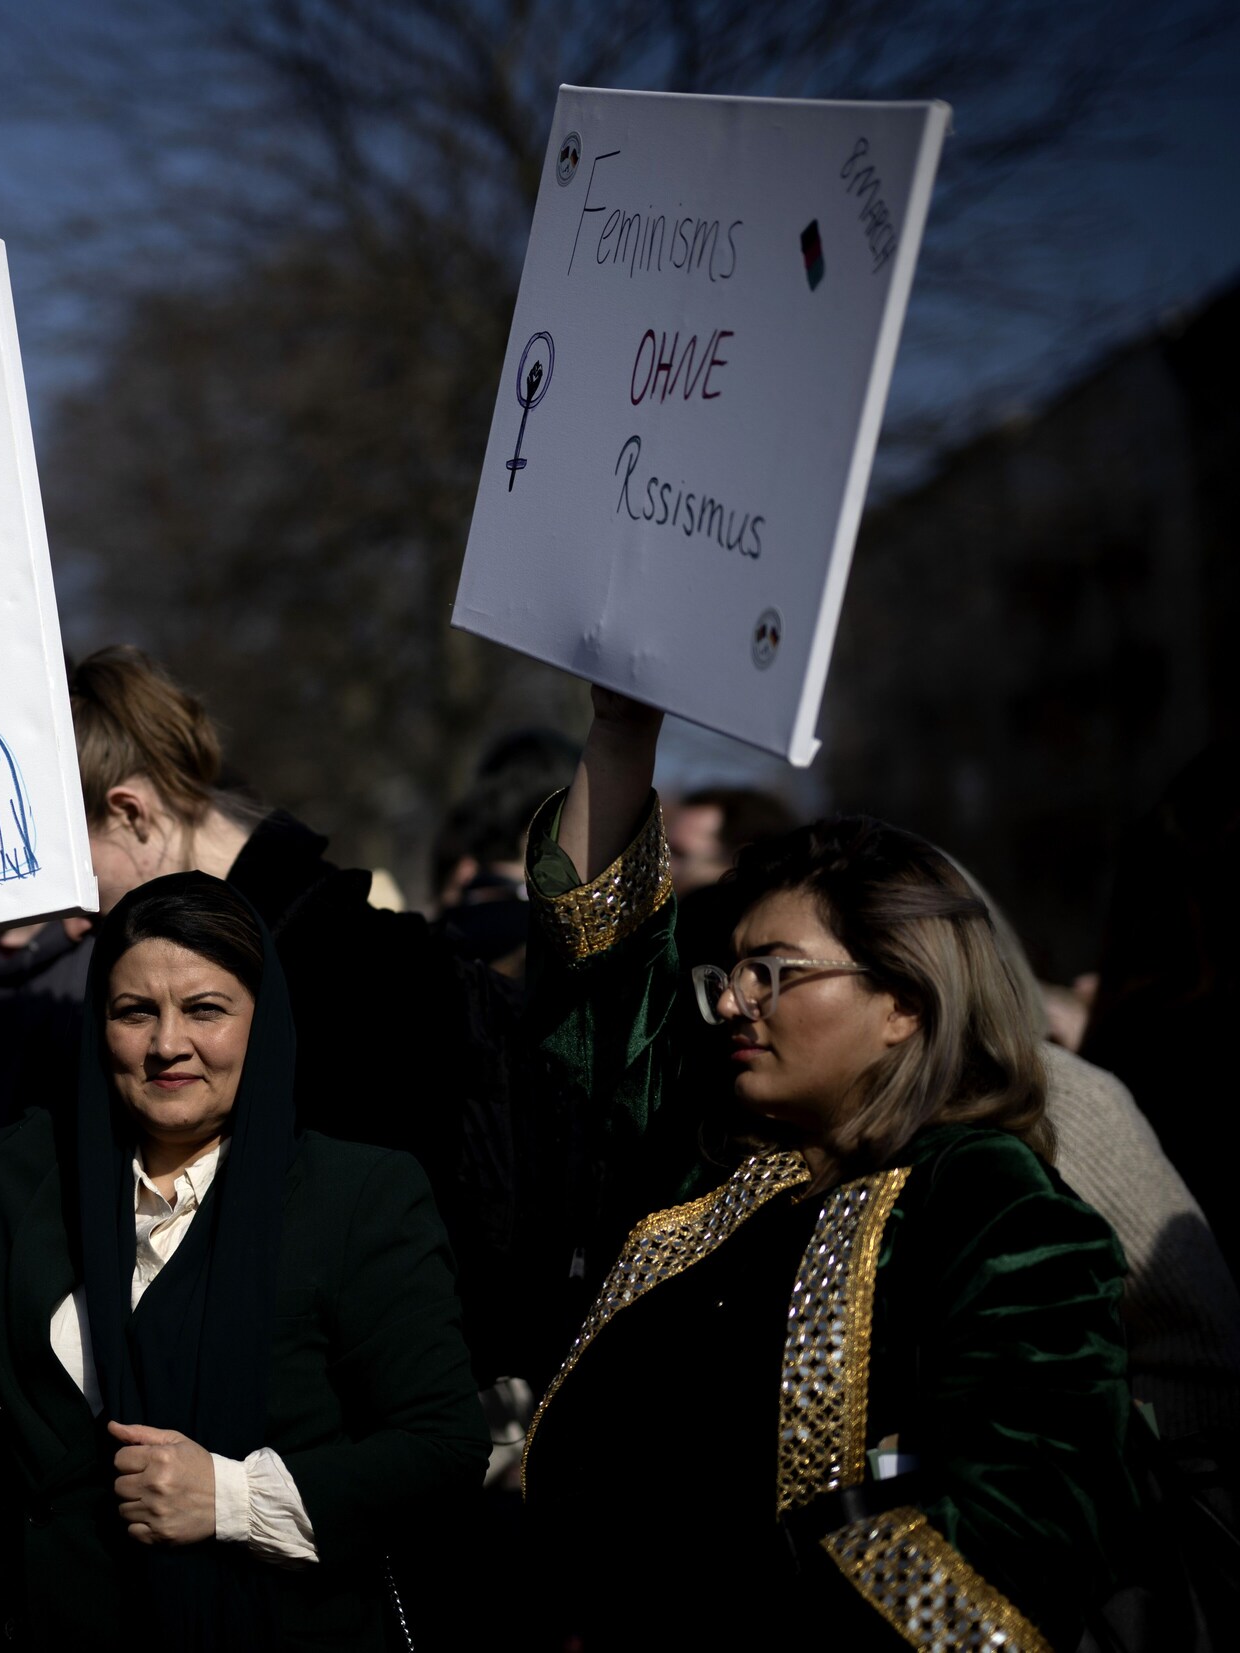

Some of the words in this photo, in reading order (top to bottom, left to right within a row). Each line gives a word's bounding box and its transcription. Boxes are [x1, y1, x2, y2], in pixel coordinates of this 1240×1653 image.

[840, 137, 869, 179] 8
[568, 151, 743, 282] Feminisms
[629, 328, 734, 406] OHNE
[615, 434, 765, 559] Rssismus
